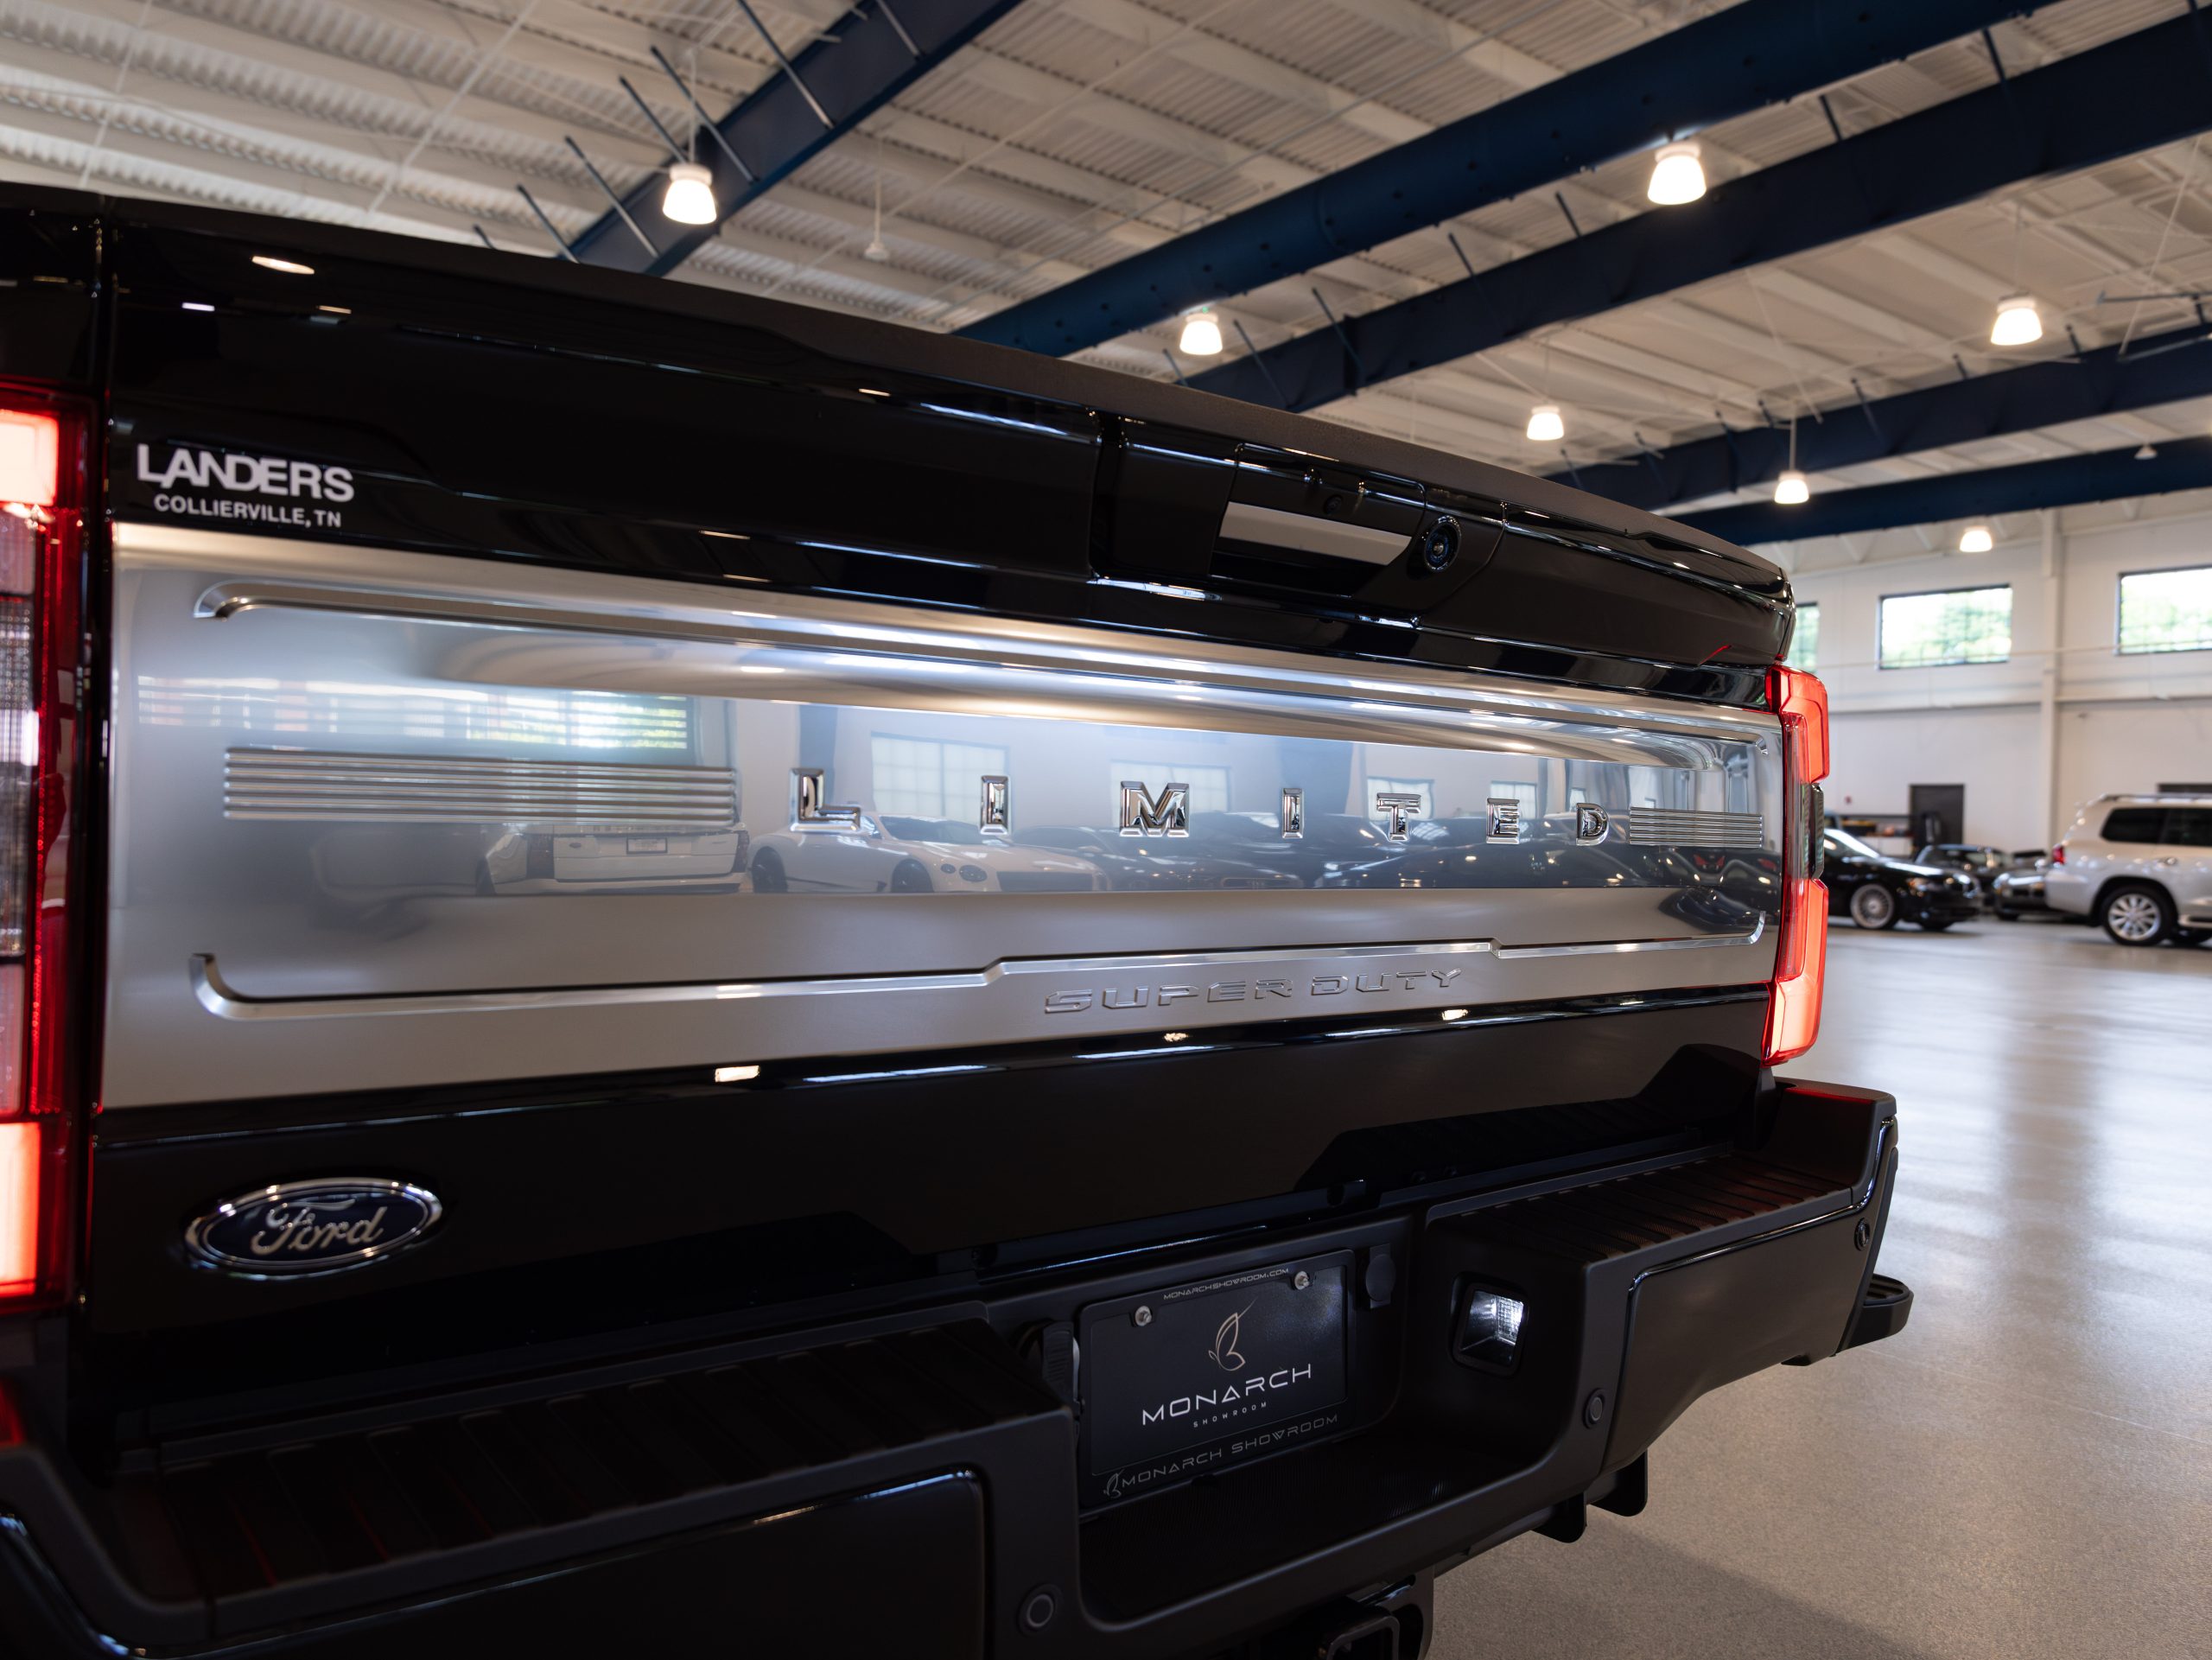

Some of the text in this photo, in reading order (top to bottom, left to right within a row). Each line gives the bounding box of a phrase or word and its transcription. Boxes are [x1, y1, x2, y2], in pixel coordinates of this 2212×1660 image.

[137, 443, 355, 503] LANDERS
[154, 493, 342, 528] COLLIERVILLE, TN
[788, 767, 1610, 846] LIMITED
[1044, 968, 1463, 1014] SUPER DUTY
[250, 1199, 388, 1255] Ford
[1163, 1268, 1289, 1301] MONARCHSHOWROOM.COM
[1142, 1364, 1312, 1426] MONARCH
[1192, 1401, 1268, 1428] SHOWROOM
[1122, 1414, 1338, 1489] MONARCH SHOWROOM
